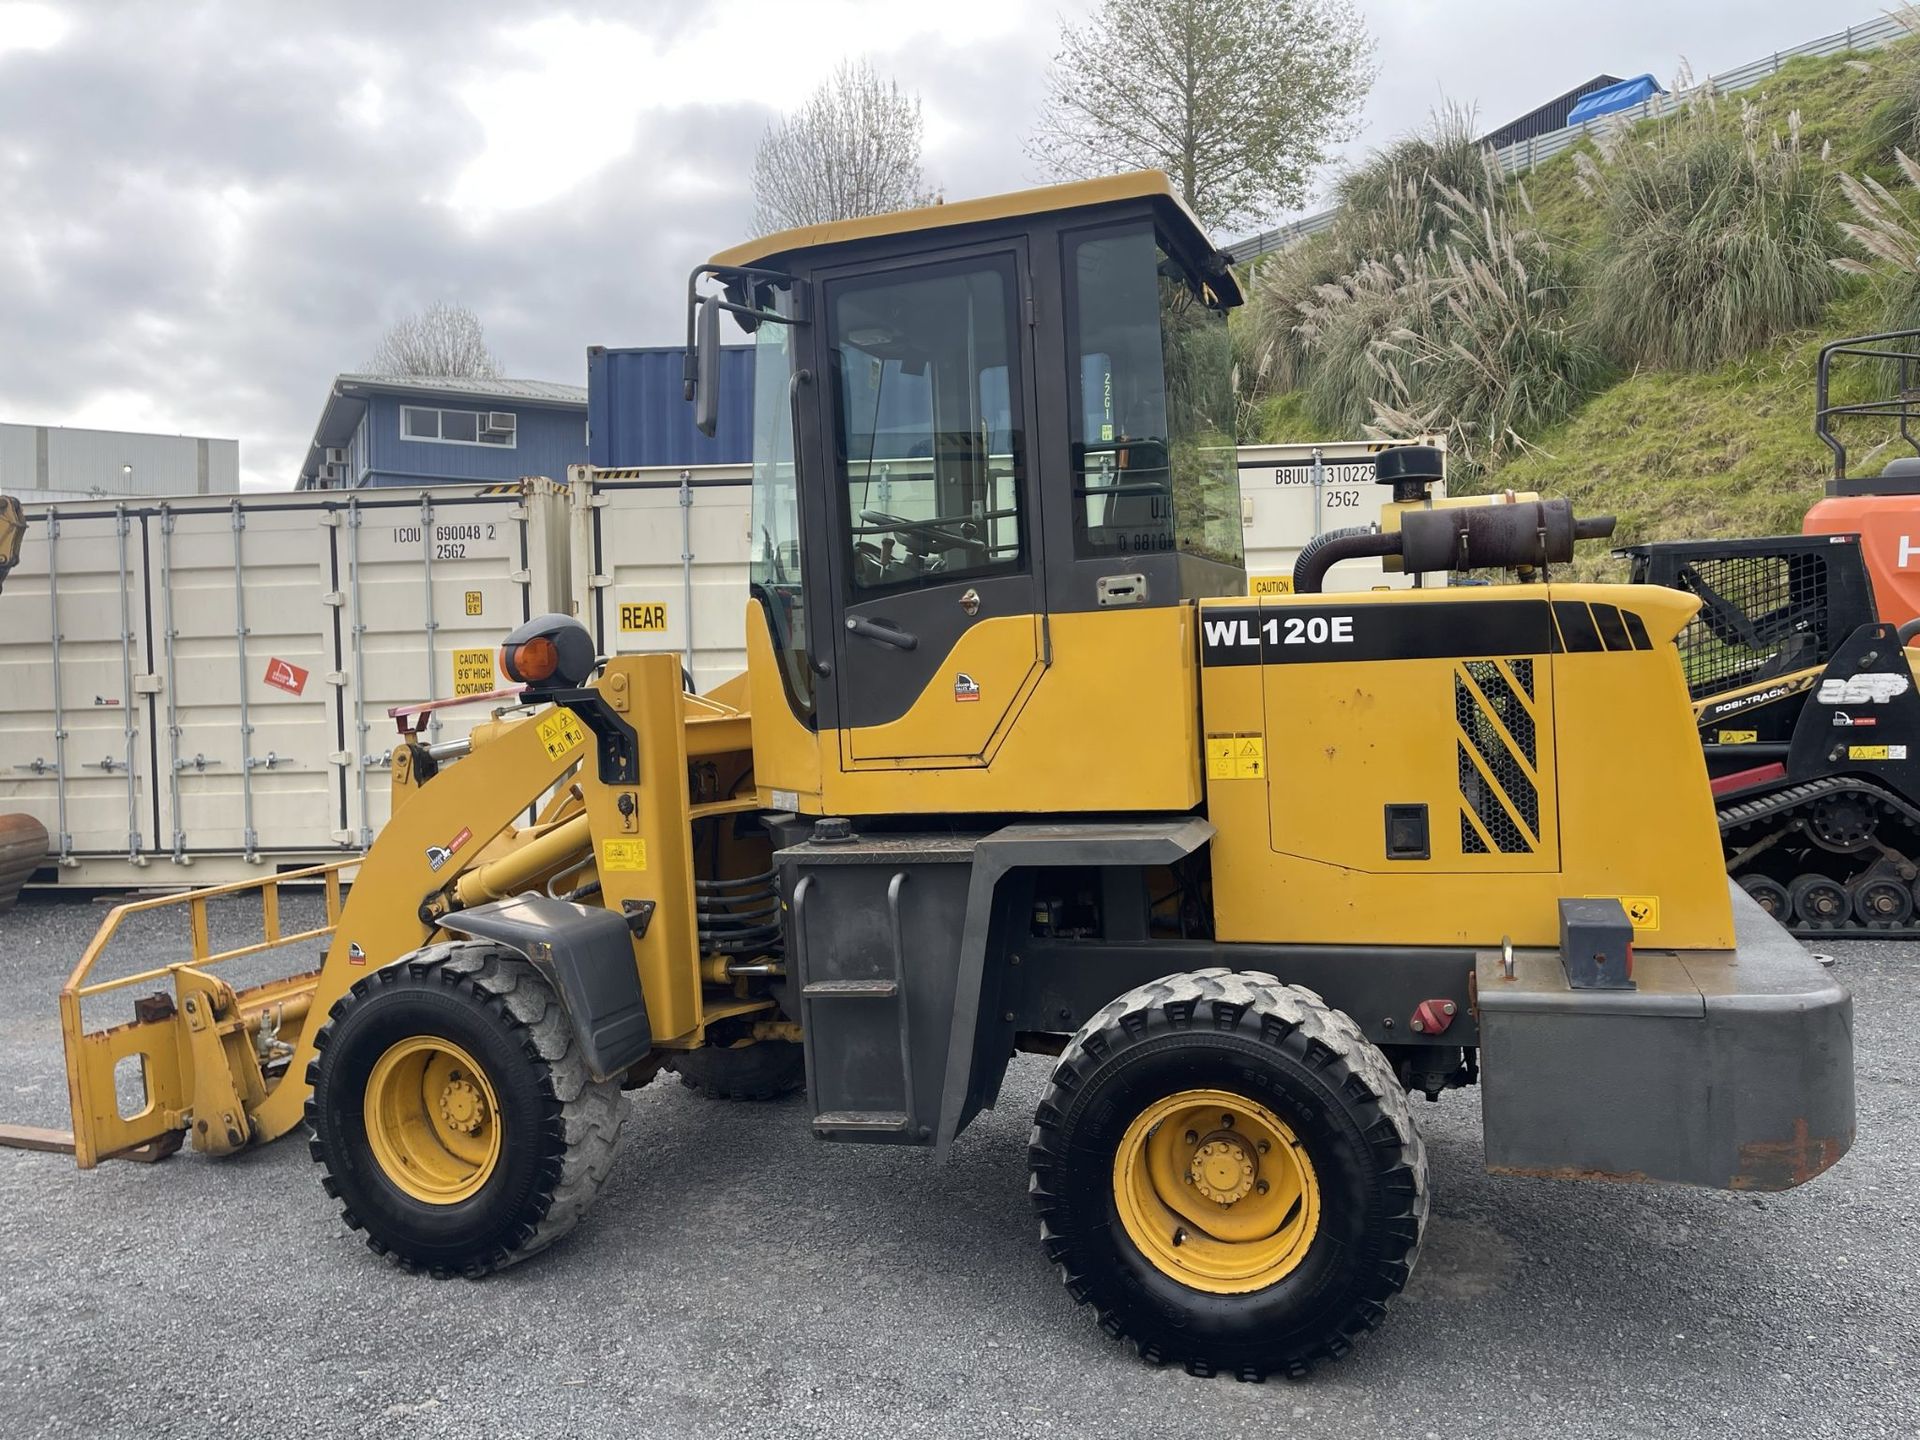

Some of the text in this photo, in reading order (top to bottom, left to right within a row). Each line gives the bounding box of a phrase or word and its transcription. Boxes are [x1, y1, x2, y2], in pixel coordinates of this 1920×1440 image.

[1275, 465, 1376, 485] BBUU 310229
[1327, 490, 1360, 508] 25G2
[436, 525, 481, 541] 690048
[487, 524, 495, 540] 2
[436, 543, 466, 559] 25G2
[1256, 581, 1289, 593] CAUTION
[622, 606, 664, 629] REAR
[1204, 616, 1354, 647] WL120E
[459, 653, 489, 665] CAUTION
[473, 668, 491, 679] HIGH
[456, 682, 494, 694] CONTAINER
